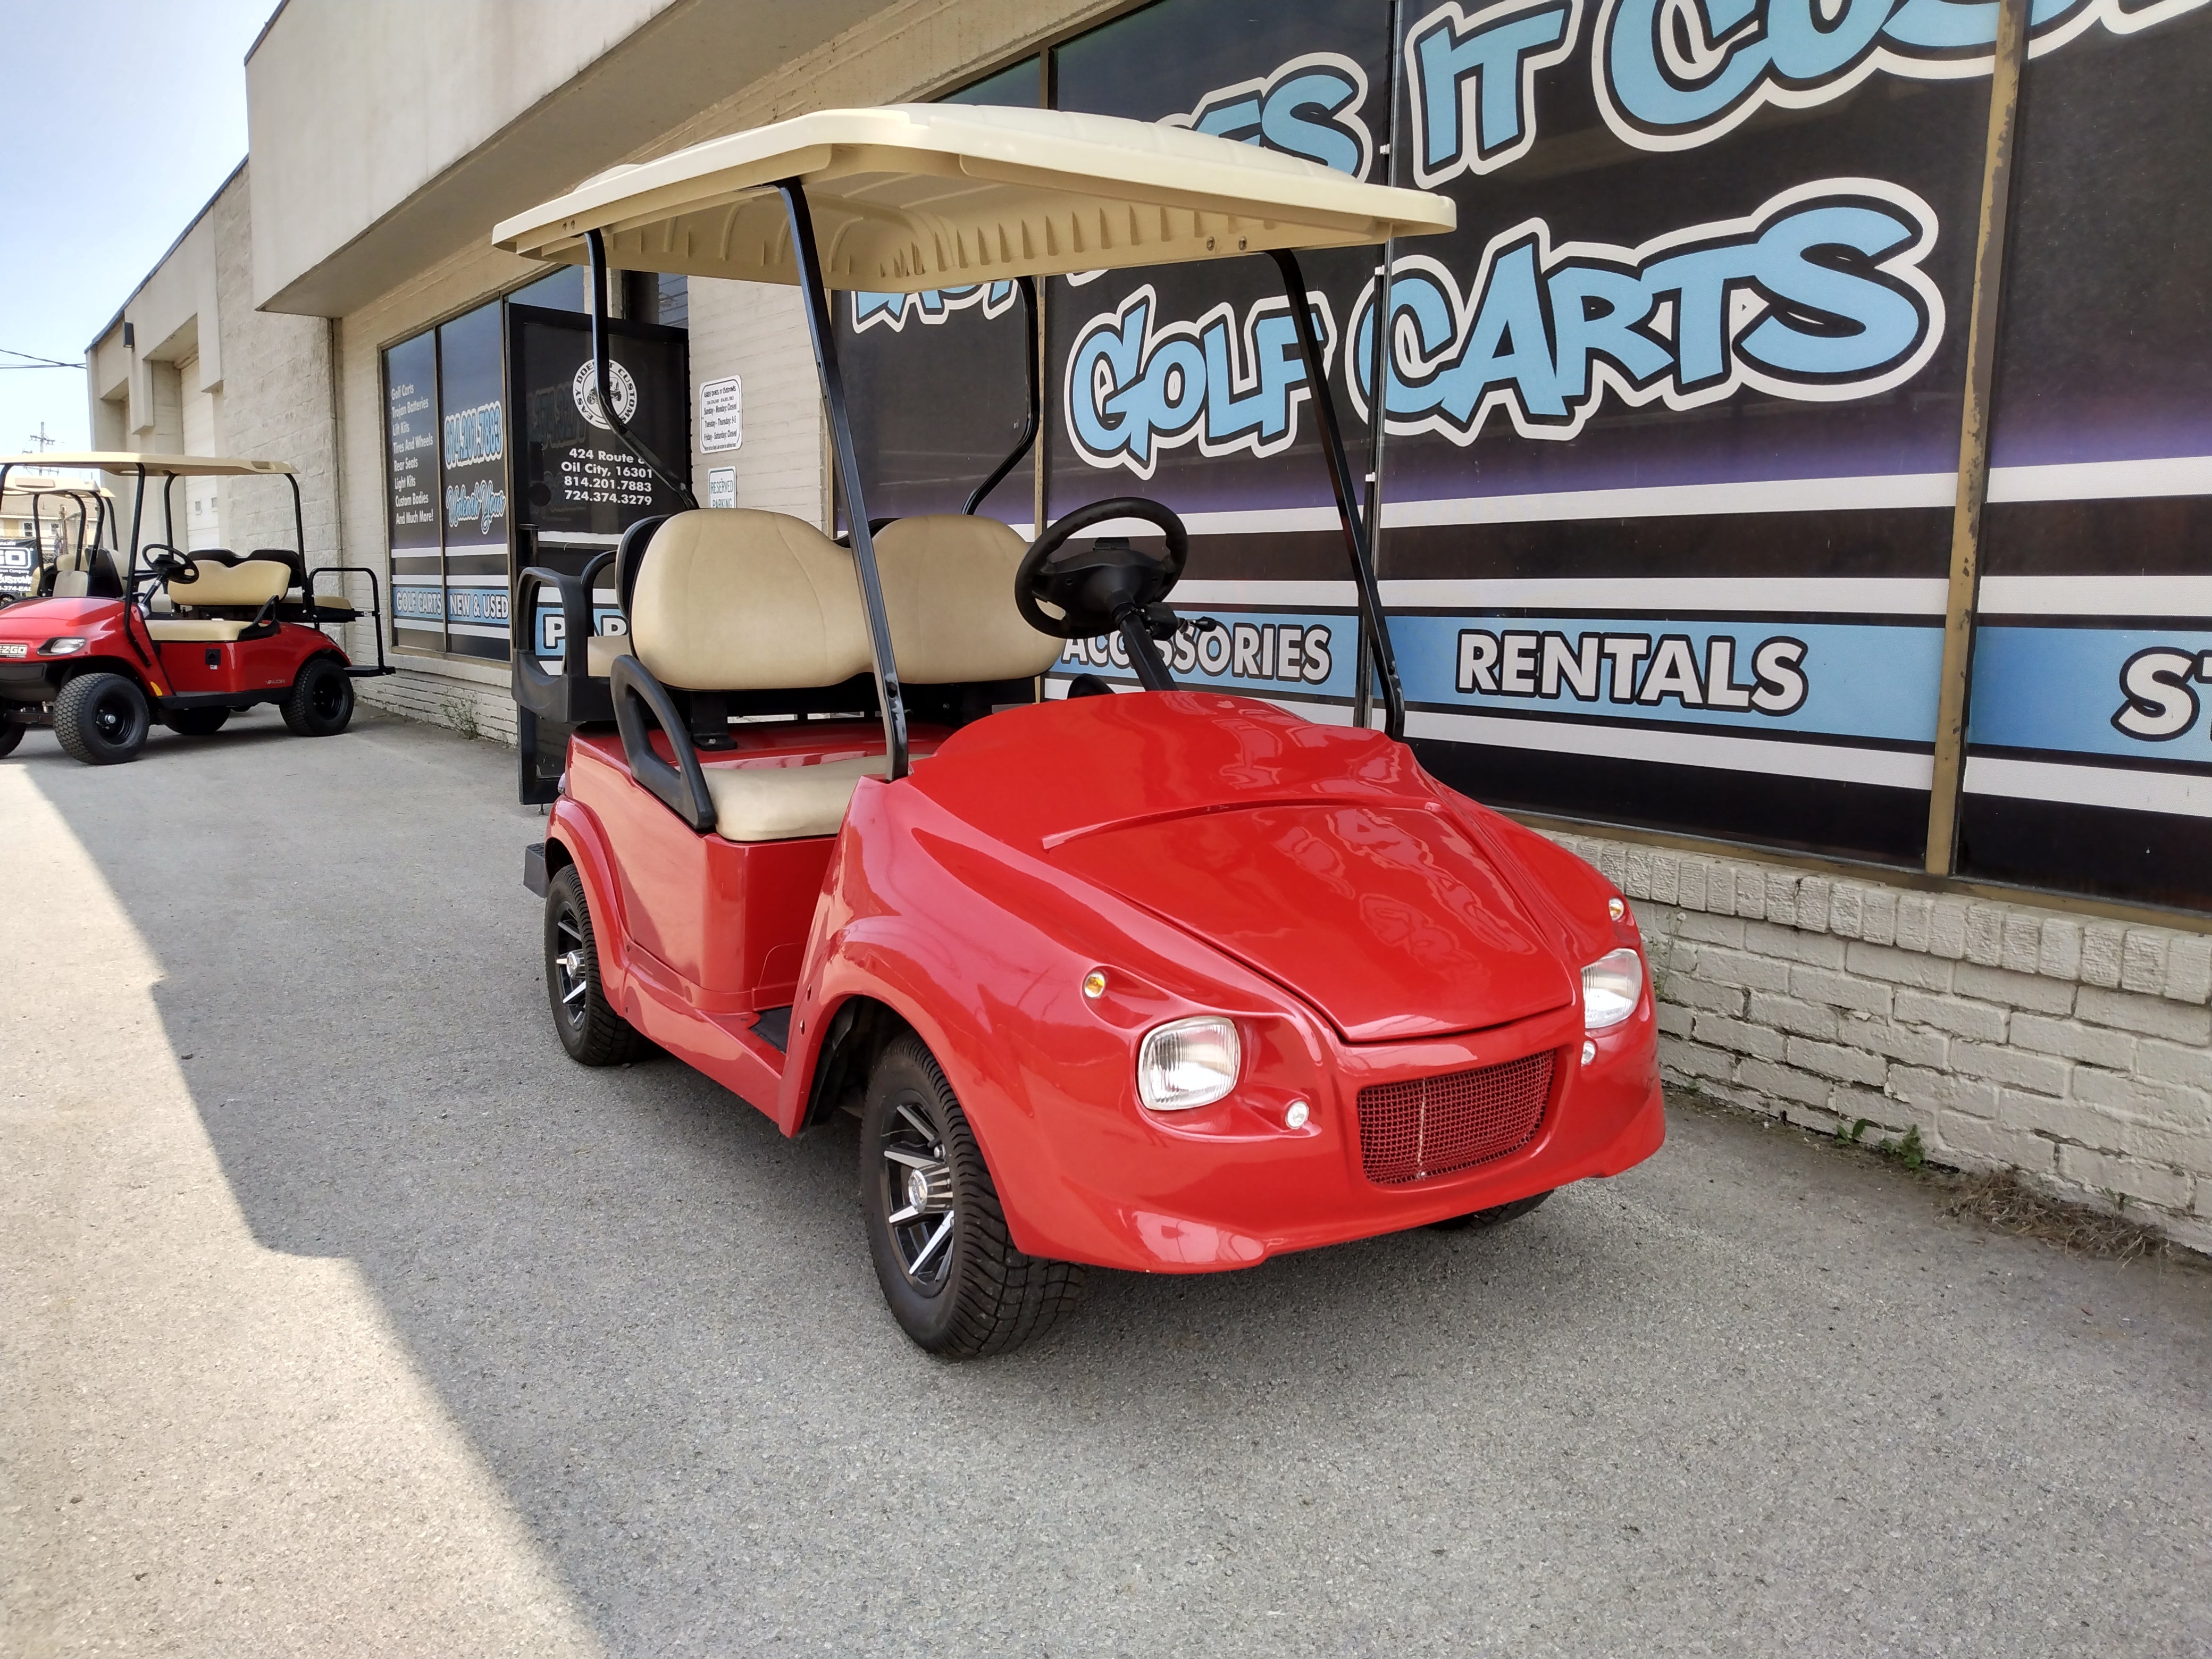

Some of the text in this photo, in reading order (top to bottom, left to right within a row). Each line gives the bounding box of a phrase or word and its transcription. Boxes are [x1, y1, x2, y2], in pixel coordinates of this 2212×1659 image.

[1068, 185, 1938, 473] GOLF CARTS
[576, 362, 594, 384] DOE
[391, 383, 414, 400] Golf Carts
[617, 368, 635, 422] CUSTOMS
[392, 396, 429, 420] Trojan Batteries
[575, 389, 593, 420] EASY
[727, 403, 736, 411] Closed
[400, 421, 409, 434] Kits
[445, 403, 502, 468] 814.201.7883
[727, 429, 737, 438] Closed
[393, 432, 433, 455] Tires And Wheels
[569, 448, 594, 459] 424
[598, 450, 634, 463] Route
[393, 457, 418, 472] Rear Seats
[561, 461, 652, 478] Oil City, 16301
[395, 475, 416, 492] Light Kits
[564, 475, 652, 492] 814.201.7883
[710, 480, 733, 494] RESERVED
[395, 491, 429, 507] Custom Bodies
[564, 490, 652, 506] 724.374.3279
[396, 508, 434, 525] And Much More!
[397, 591, 441, 615] GOLF CARTS
[450, 593, 509, 619] NEW & USED
[1457, 630, 1809, 716] RENTALS
